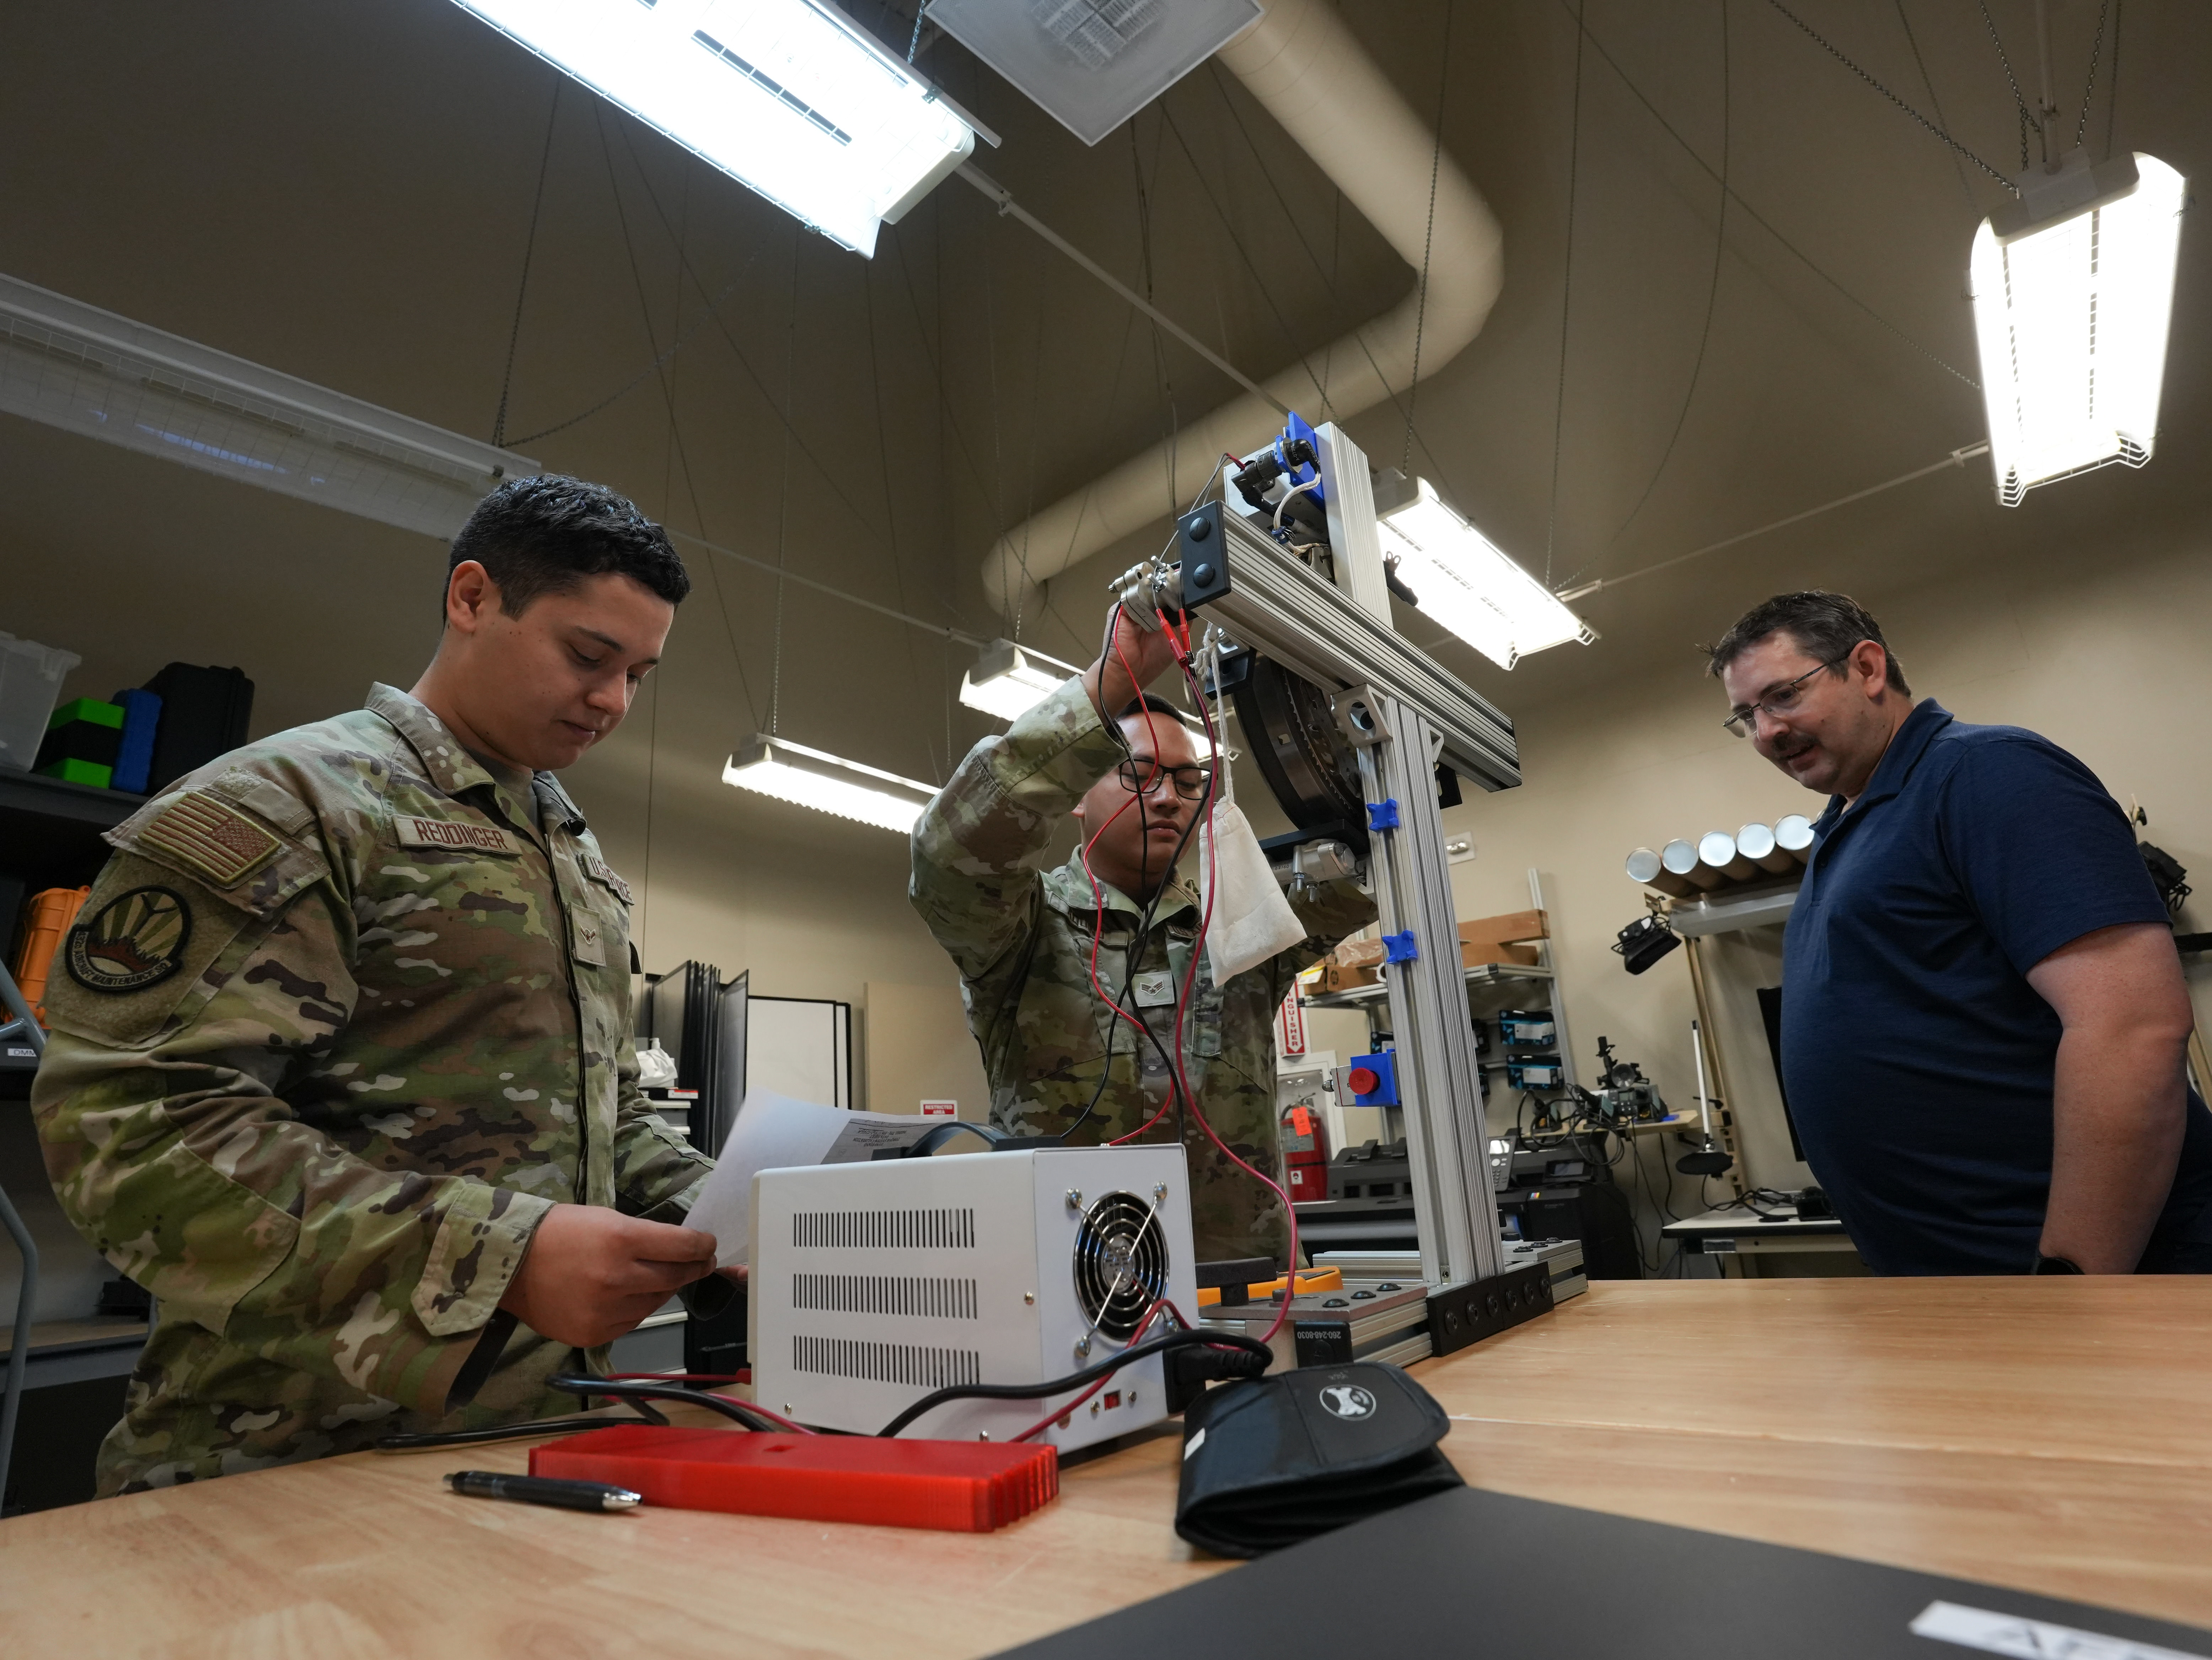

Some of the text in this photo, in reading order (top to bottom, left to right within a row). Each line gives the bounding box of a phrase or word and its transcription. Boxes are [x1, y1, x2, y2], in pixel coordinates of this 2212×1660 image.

[413, 820, 509, 850] REDDINGER
[75, 950, 95, 978] AIRCRAFT
[90, 970, 154, 986] MAINTENANCE
[1287, 992, 1298, 1046] INGUISHER
[1297, 1331, 1341, 1339] 260-248-8030
